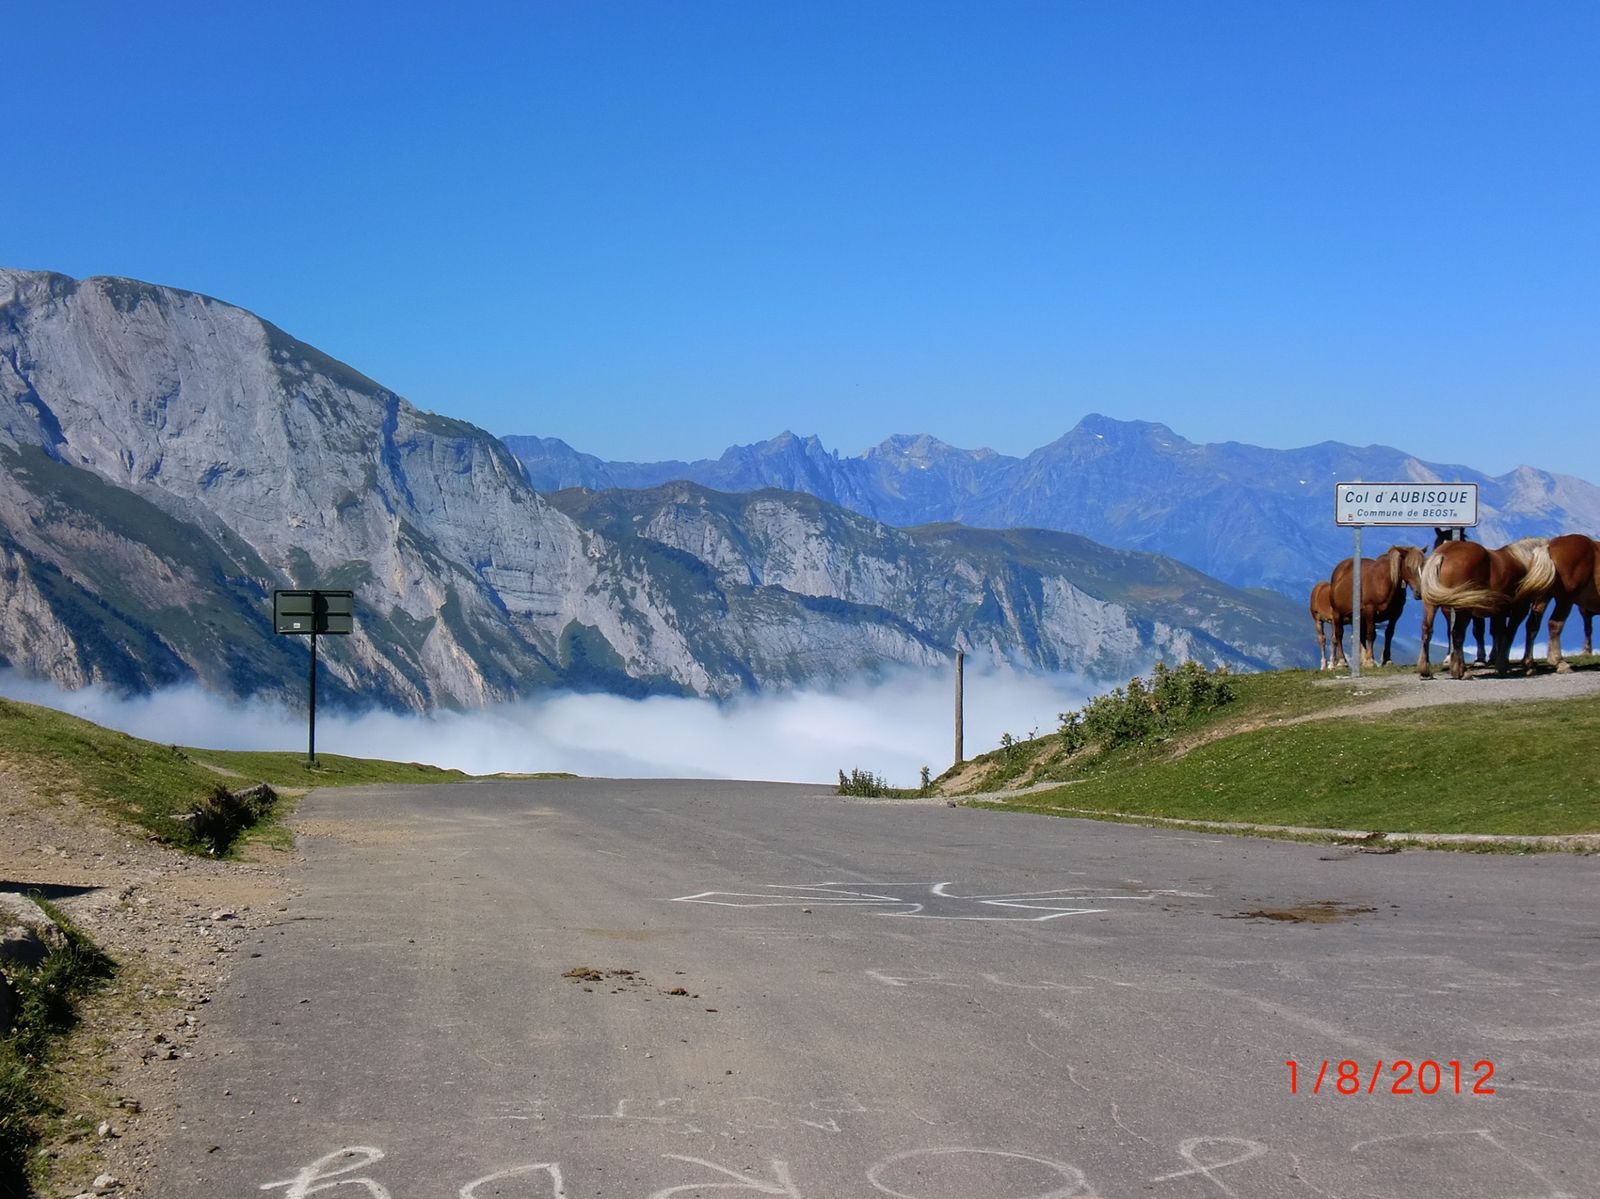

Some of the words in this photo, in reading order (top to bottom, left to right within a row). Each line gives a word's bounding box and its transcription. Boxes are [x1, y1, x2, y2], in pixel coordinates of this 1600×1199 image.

[1345, 491, 1368, 503] Col
[1375, 491, 1468, 503] d'AUBISQUE
[1357, 508, 1403, 517] Commune
[1407, 508, 1419, 517] de
[1423, 508, 1455, 517] BEOST
